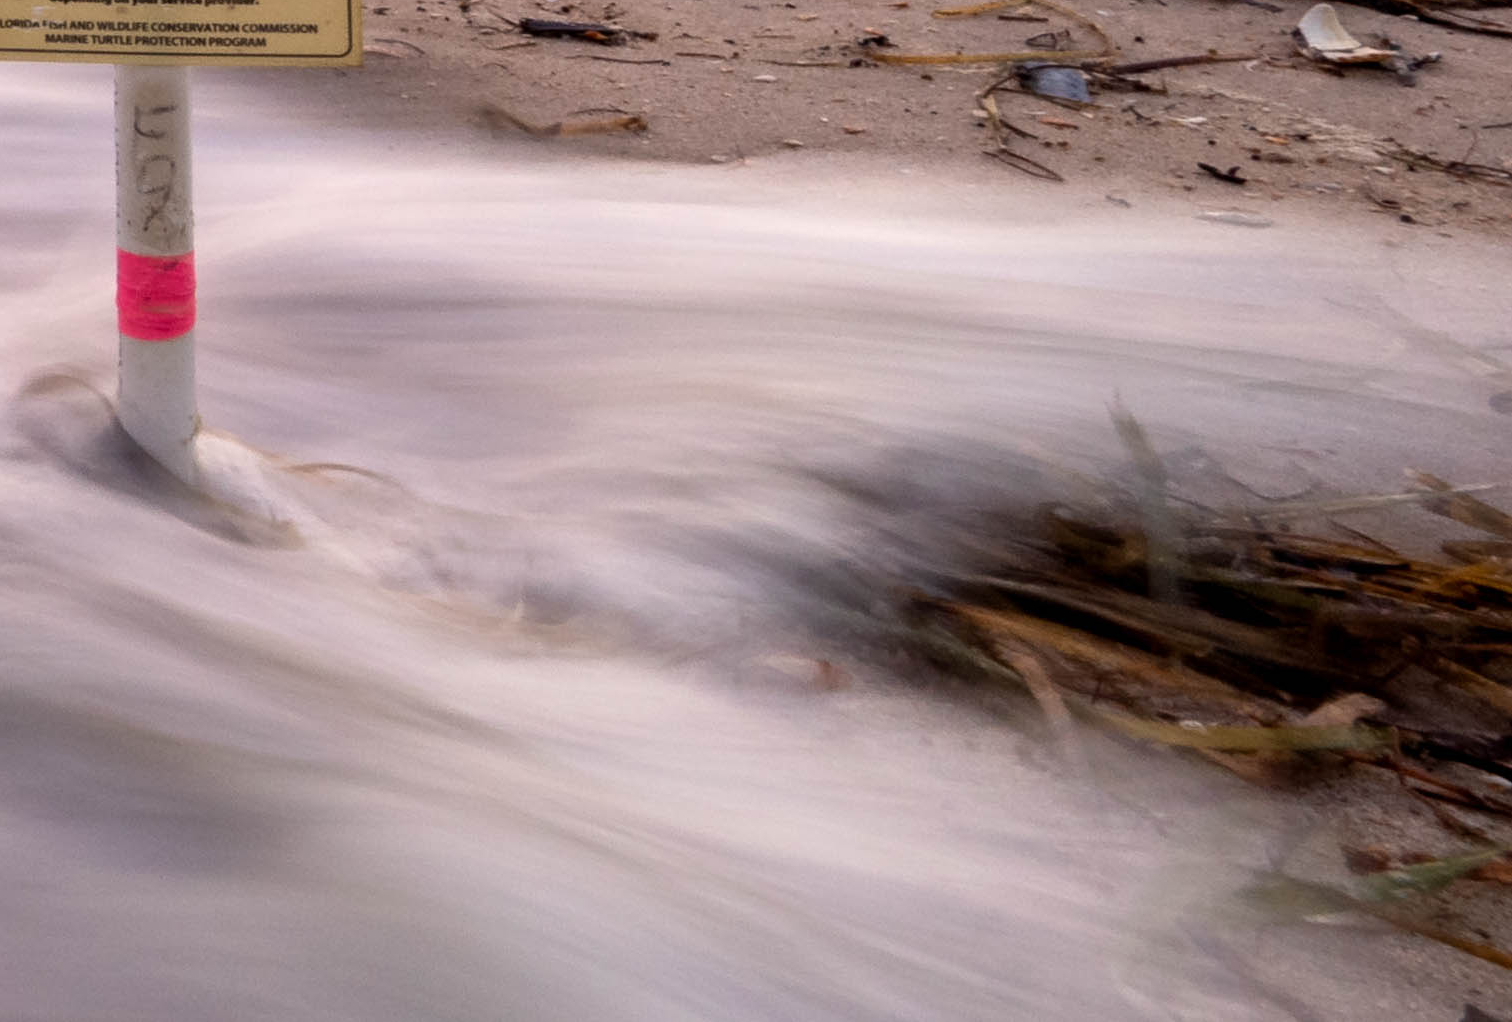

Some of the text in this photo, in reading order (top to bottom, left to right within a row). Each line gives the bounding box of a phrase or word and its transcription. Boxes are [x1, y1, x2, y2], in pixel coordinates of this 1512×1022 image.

[69, 21, 95, 30] AND
[96, 21, 149, 32] WILDLIFE
[150, 22, 240, 33] CONSERVATION
[241, 23, 318, 34] COMMISSION
[44, 33, 266, 47] MARINE TURTLE PROTECTION PROGRAM
